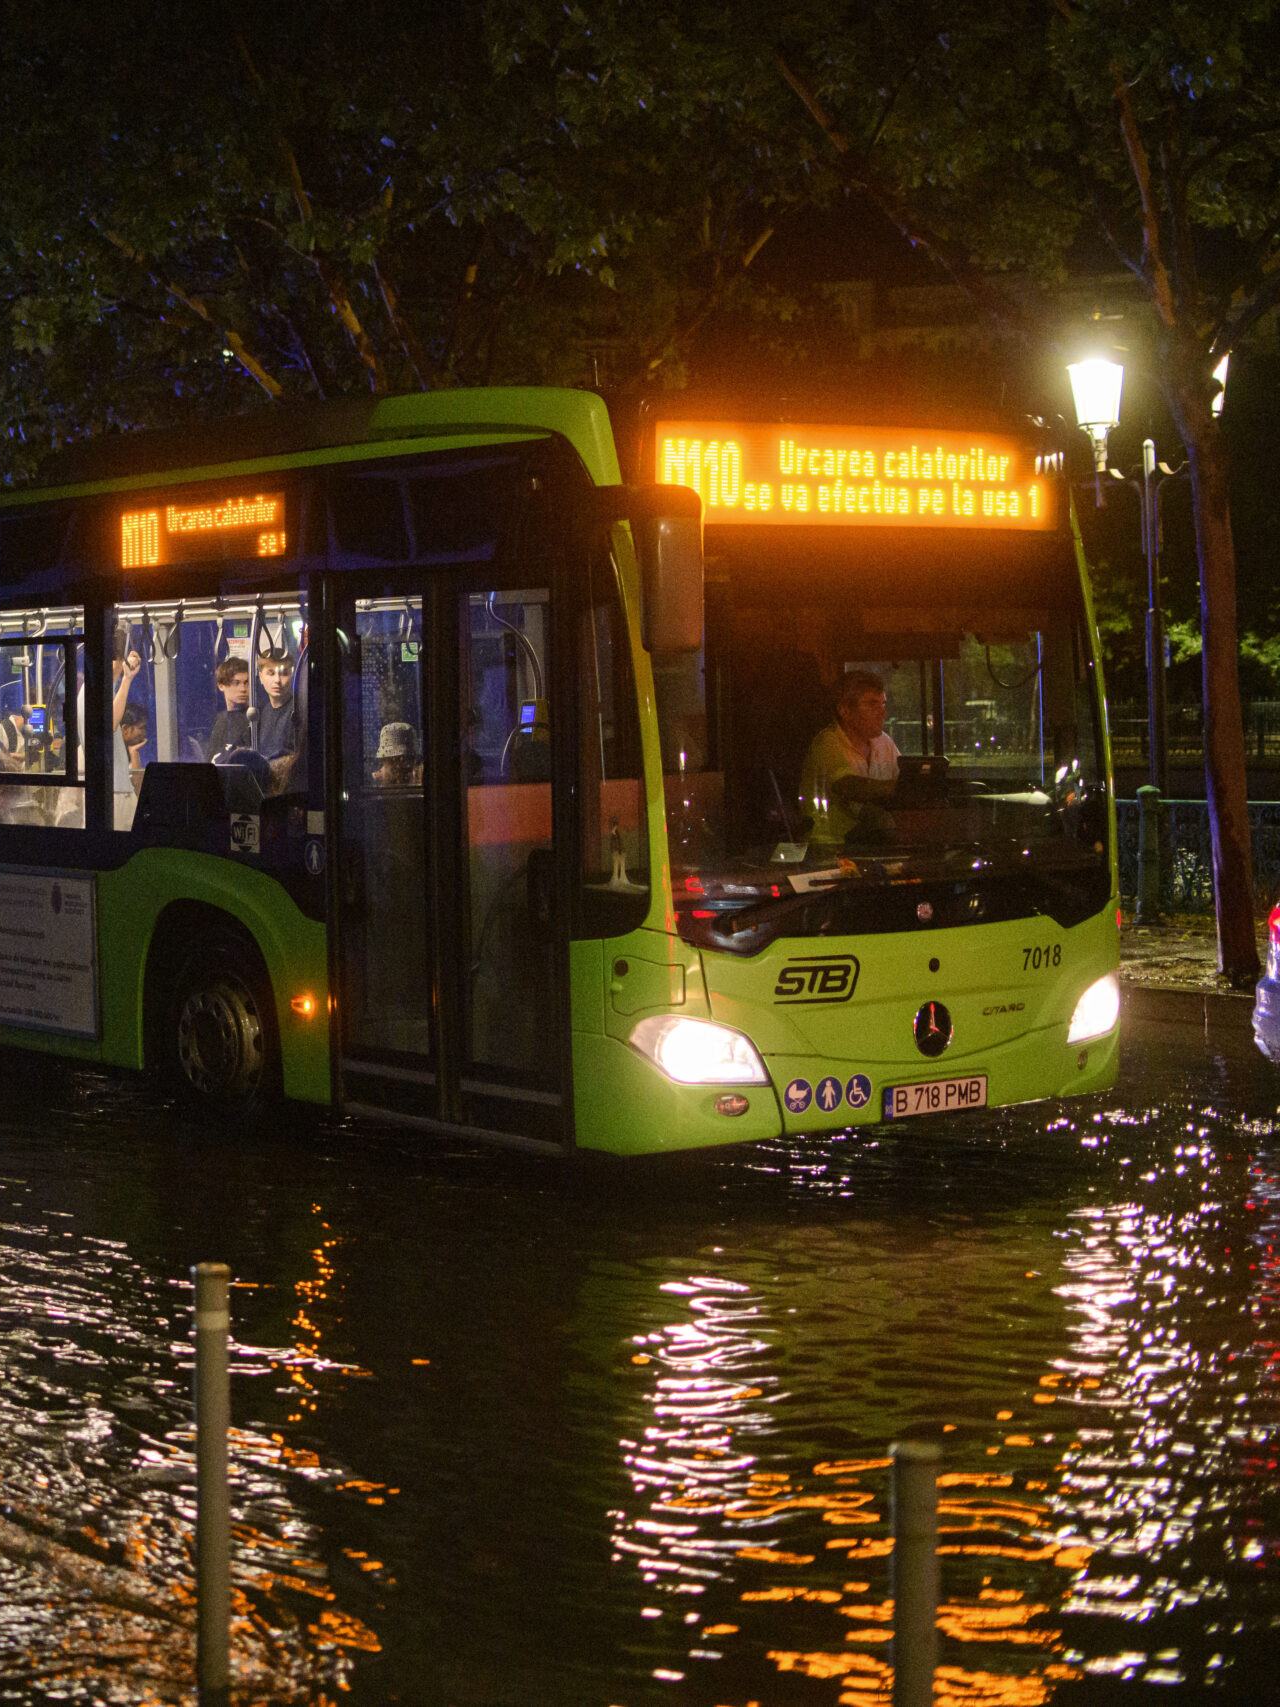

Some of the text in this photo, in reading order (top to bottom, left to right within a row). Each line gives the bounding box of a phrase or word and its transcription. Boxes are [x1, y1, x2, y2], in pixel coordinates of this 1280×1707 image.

[778, 440, 875, 478] Urcarea
[884, 445, 1010, 481] calatorilor
[743, 480, 1039, 517] se va efectua pe la usa 1
[1022, 944, 1062, 970] 7018
[774, 964, 852, 995] STB
[982, 1002, 1025, 1016] CITARO
[896, 1080, 981, 1113] B 718 PMB
